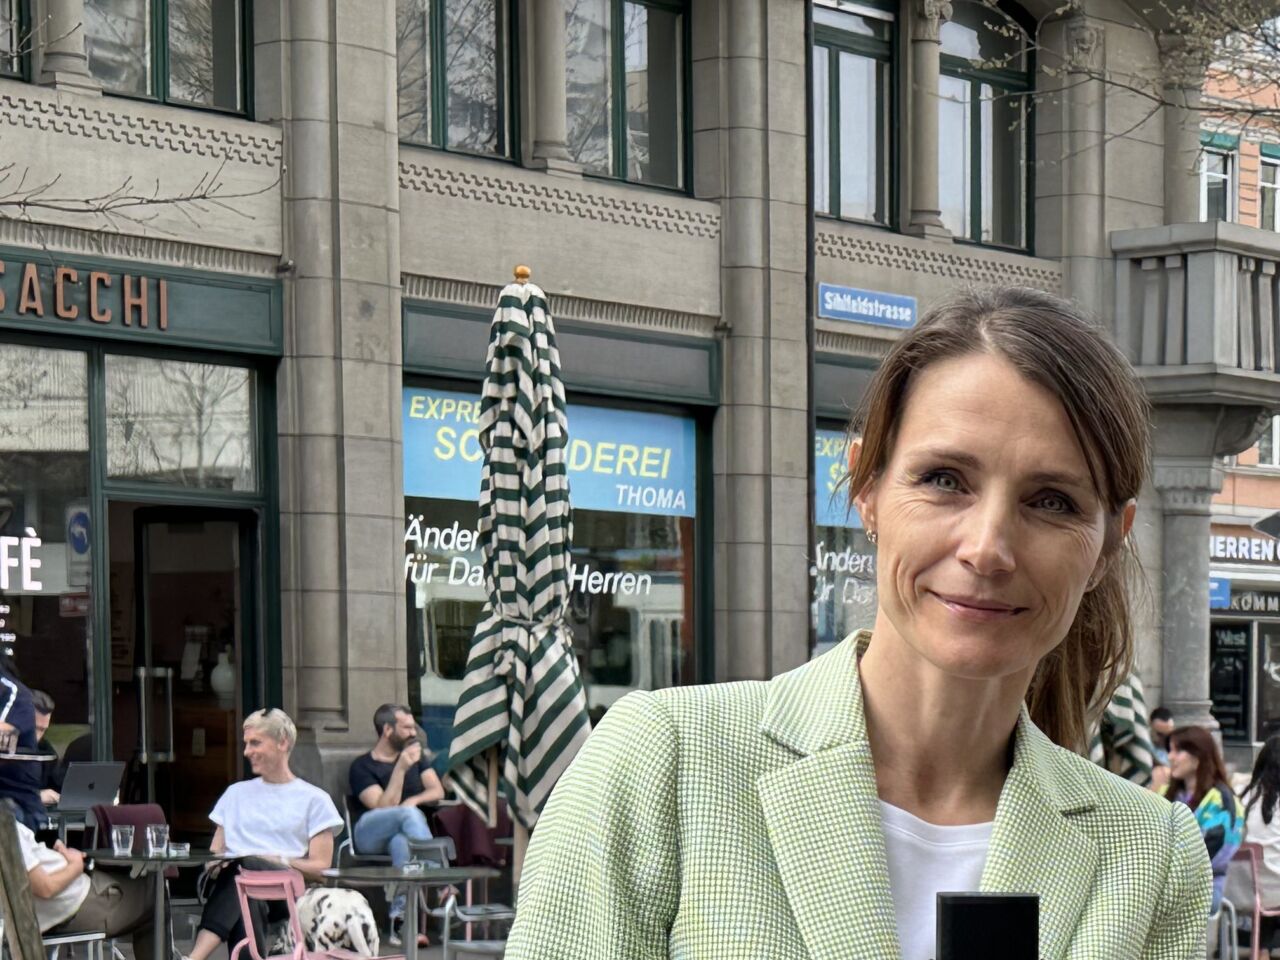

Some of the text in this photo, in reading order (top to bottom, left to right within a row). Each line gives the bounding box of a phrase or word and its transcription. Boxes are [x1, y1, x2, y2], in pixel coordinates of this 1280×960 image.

[0, 260, 168, 331] ACCHI
[409, 395, 482, 424] EXPRE
[616, 484, 686, 510] THOMA
[404, 514, 480, 552] Änder
[405, 553, 652, 595] für Da Herren
